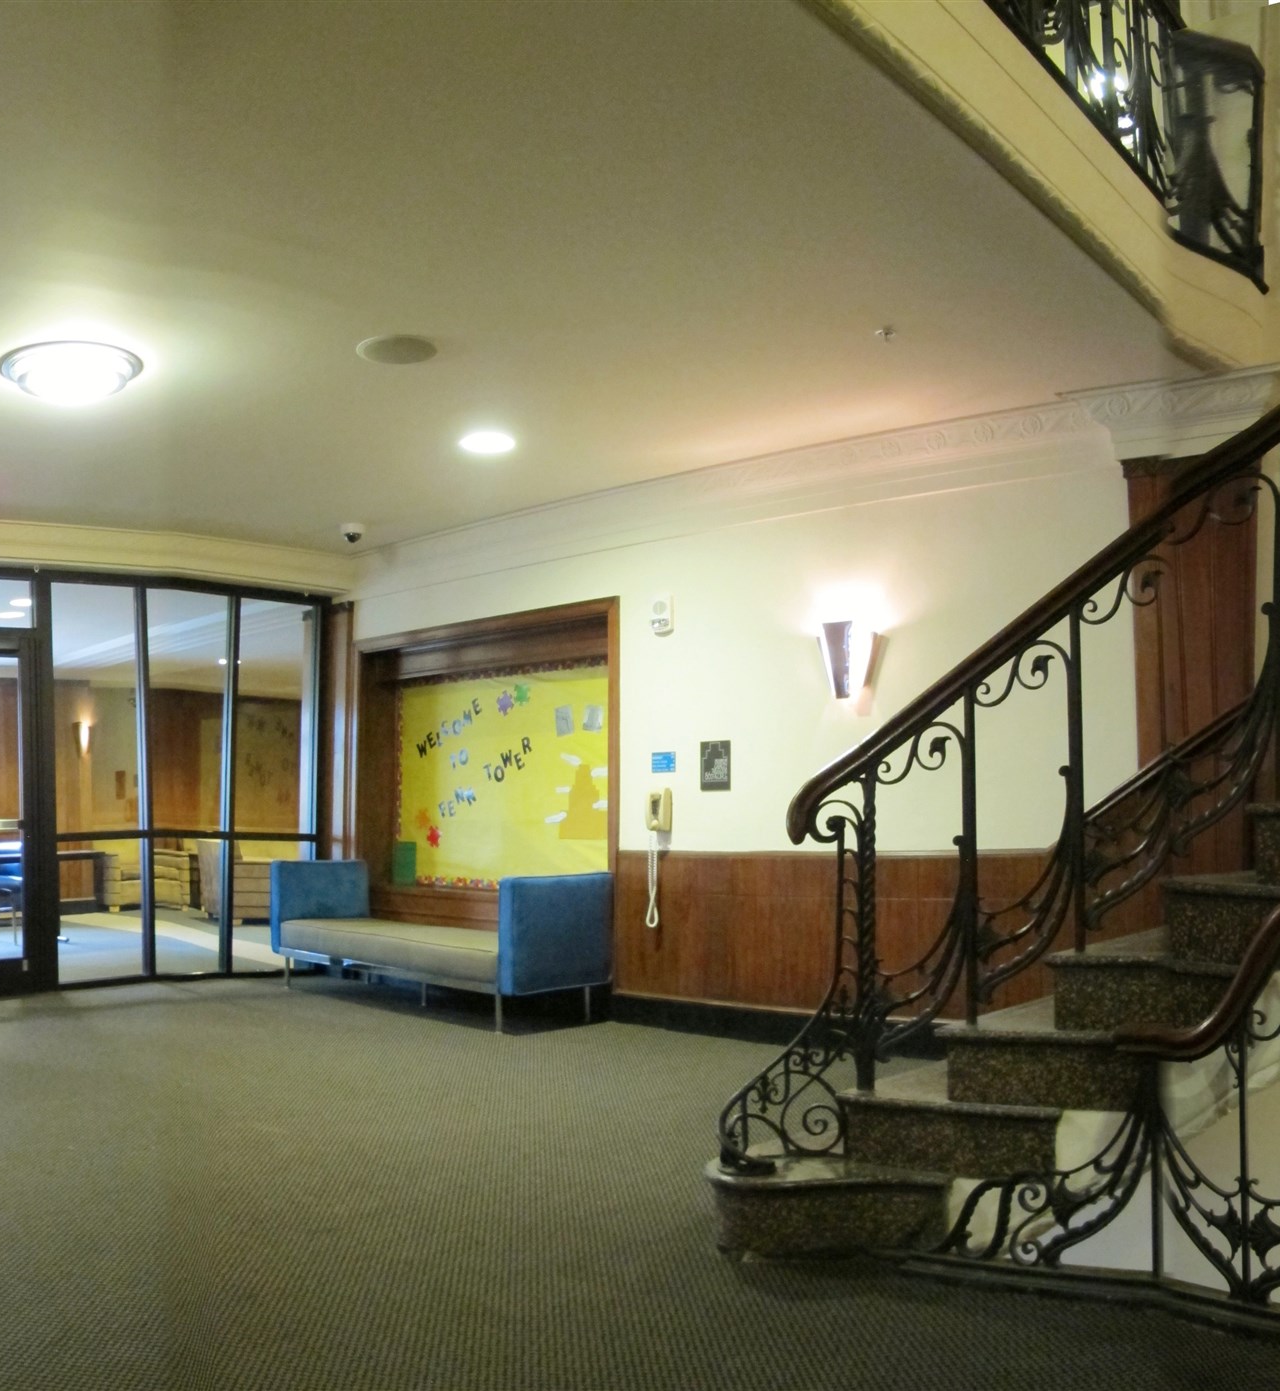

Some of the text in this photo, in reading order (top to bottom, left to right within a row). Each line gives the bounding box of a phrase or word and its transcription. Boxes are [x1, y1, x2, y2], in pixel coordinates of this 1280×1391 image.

[416, 698, 483, 759] WELCOME
[438, 736, 533, 818] FENN TOWER
